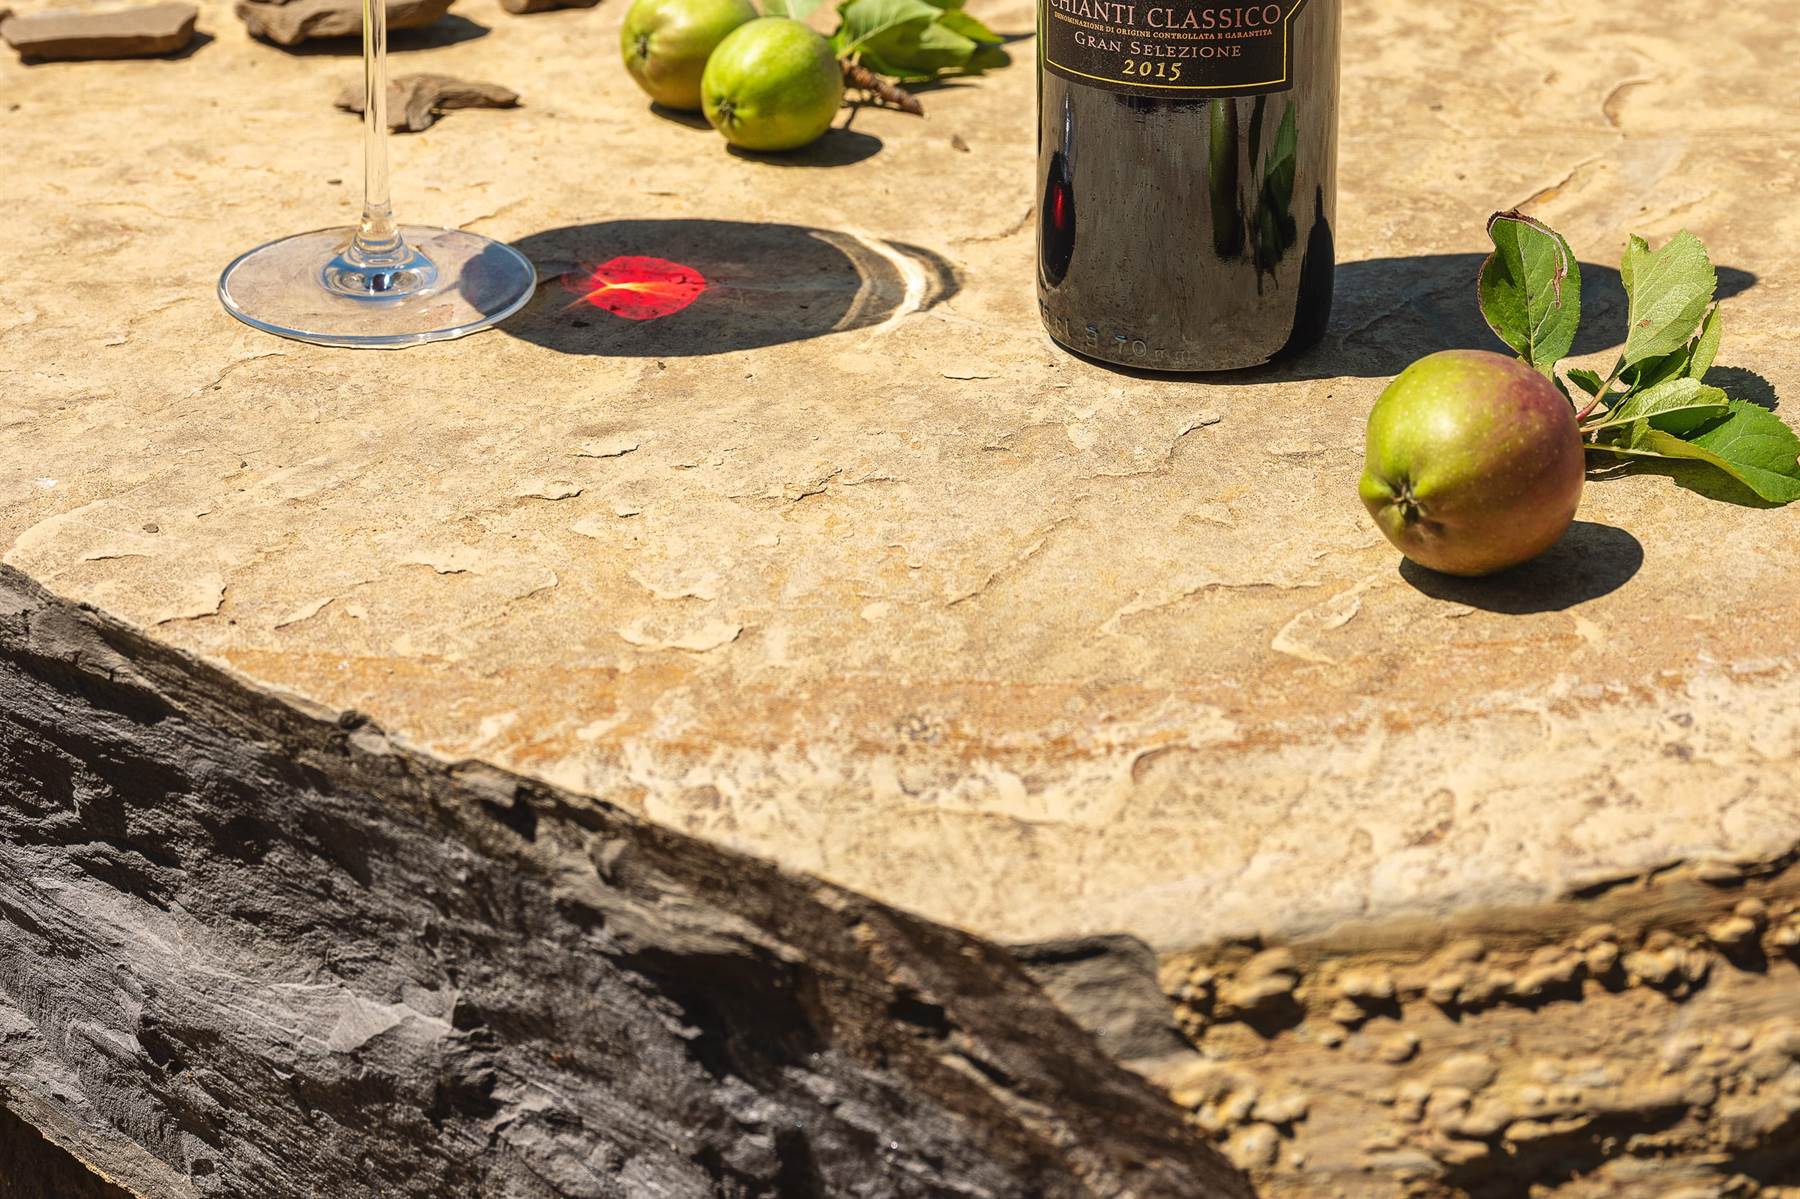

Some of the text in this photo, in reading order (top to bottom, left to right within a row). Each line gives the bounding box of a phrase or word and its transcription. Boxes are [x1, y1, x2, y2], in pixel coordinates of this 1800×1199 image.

[1054, 11, 1104, 33] DENOMINAZIONE
[1116, 28, 1151, 39] ORIGINE
[1152, 31, 1215, 40] CONTROLLATA
[1225, 28, 1273, 39] GARANTITA
[1147, 4, 1281, 30] CLASSICO
[1074, 31, 1241, 58] GRAN SELEZIONE
[1122, 59, 1182, 82] 2015
